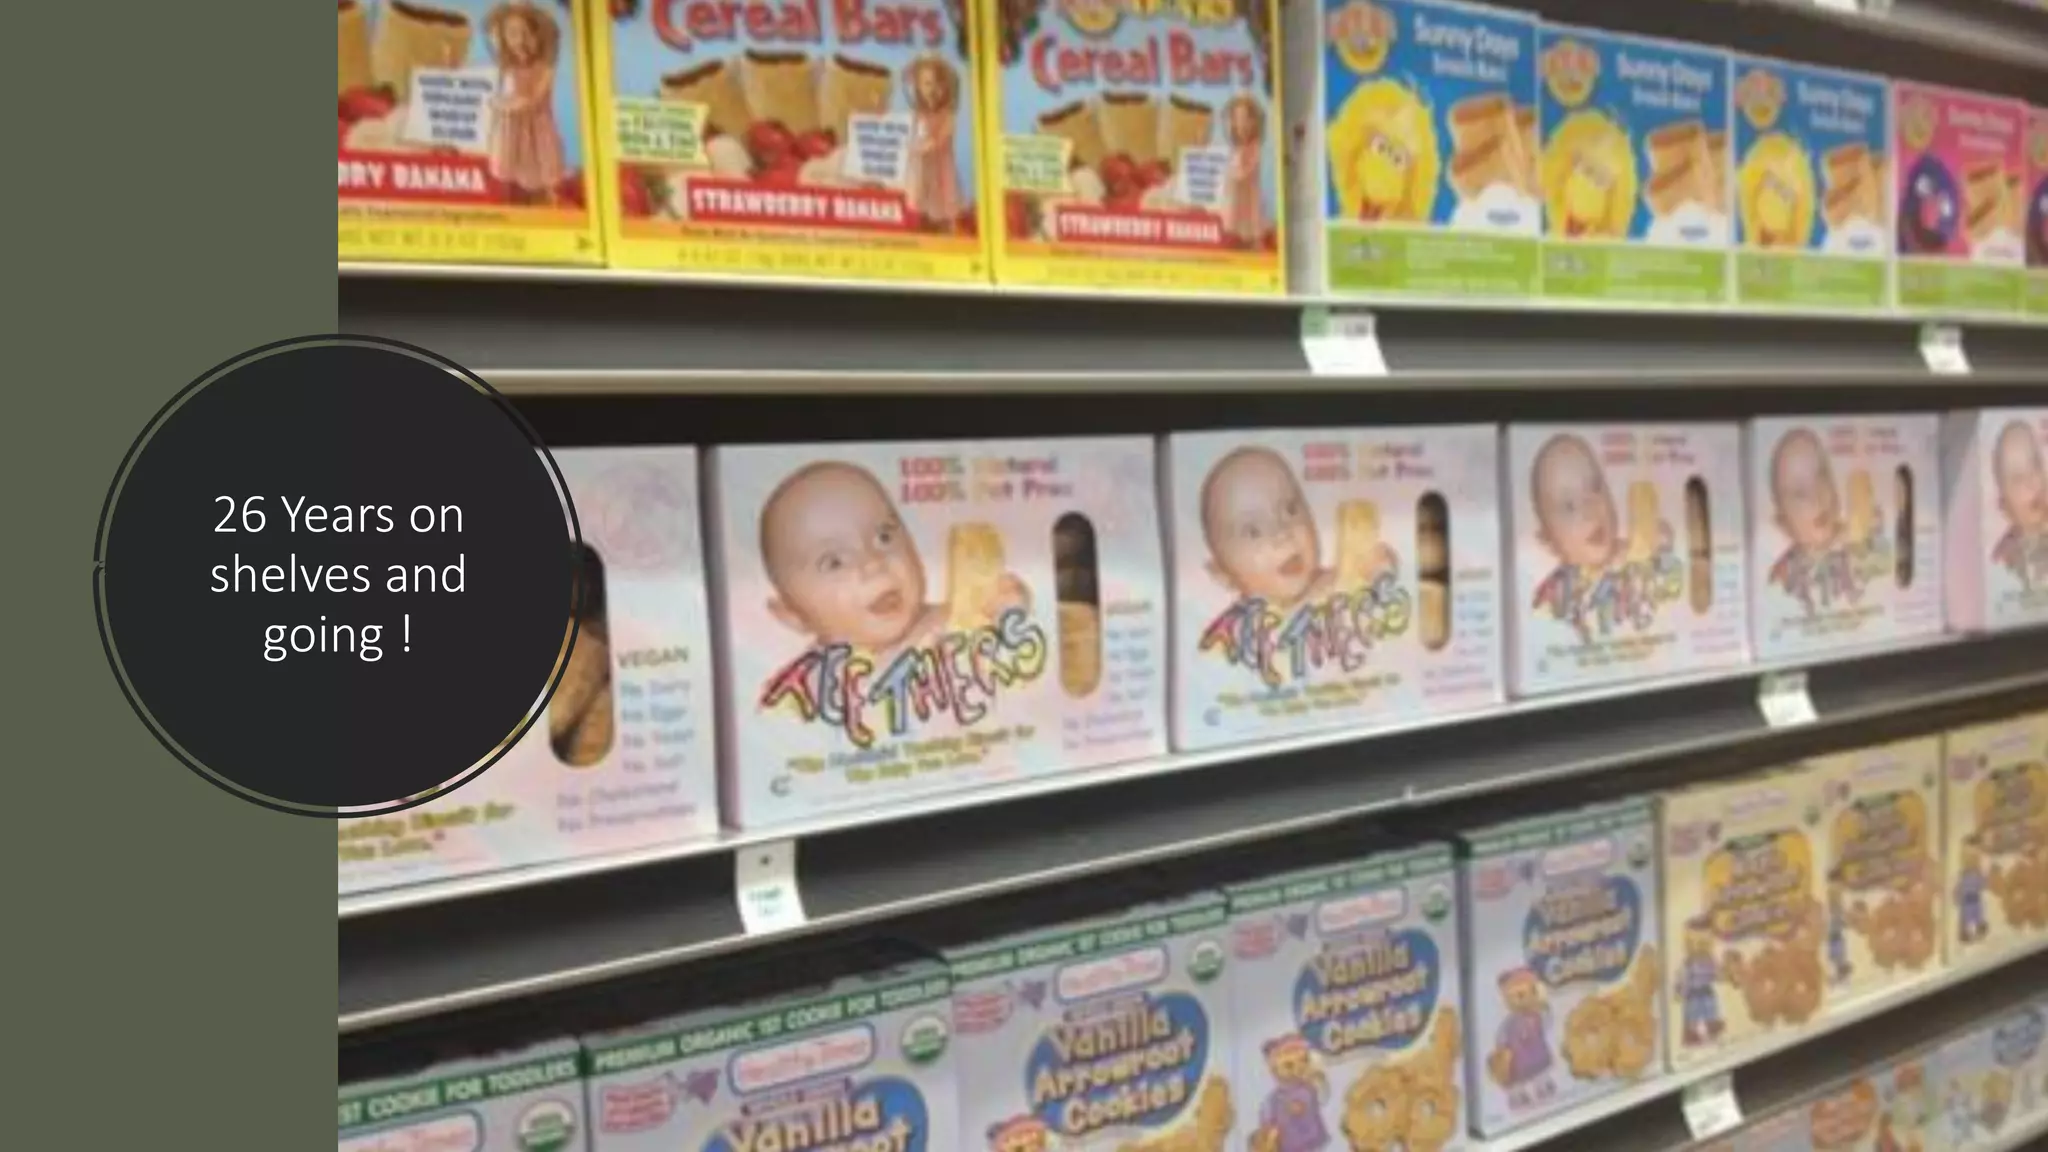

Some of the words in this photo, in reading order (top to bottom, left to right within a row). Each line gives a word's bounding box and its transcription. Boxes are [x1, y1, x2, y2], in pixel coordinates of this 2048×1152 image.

[652, 0, 822, 53] Cereal
[833, 0, 946, 46] Bars
[1029, 29, 1162, 93] Cereal
[1168, 27, 1253, 85] Bars
[391, 163, 488, 193] BANANA
[692, 187, 828, 218] STRAWBERRY
[832, 196, 904, 223] BANANA
[1059, 213, 1162, 241] STRAWBERRY
[617, 646, 689, 669] VEGAN
[1315, 939, 1411, 986] Vanilla
[847, 993, 876, 1015] FOR
[1051, 1002, 1171, 1063] Vanilla
[366, 1086, 440, 1118] COOKIE
[445, 1077, 482, 1101] FOR
[487, 1057, 578, 1093] TODDLERS
[1033, 1026, 1196, 1103] Arrowroot
[726, 1094, 882, 1152] Vanilla
[1063, 1073, 1187, 1135] Cookies
